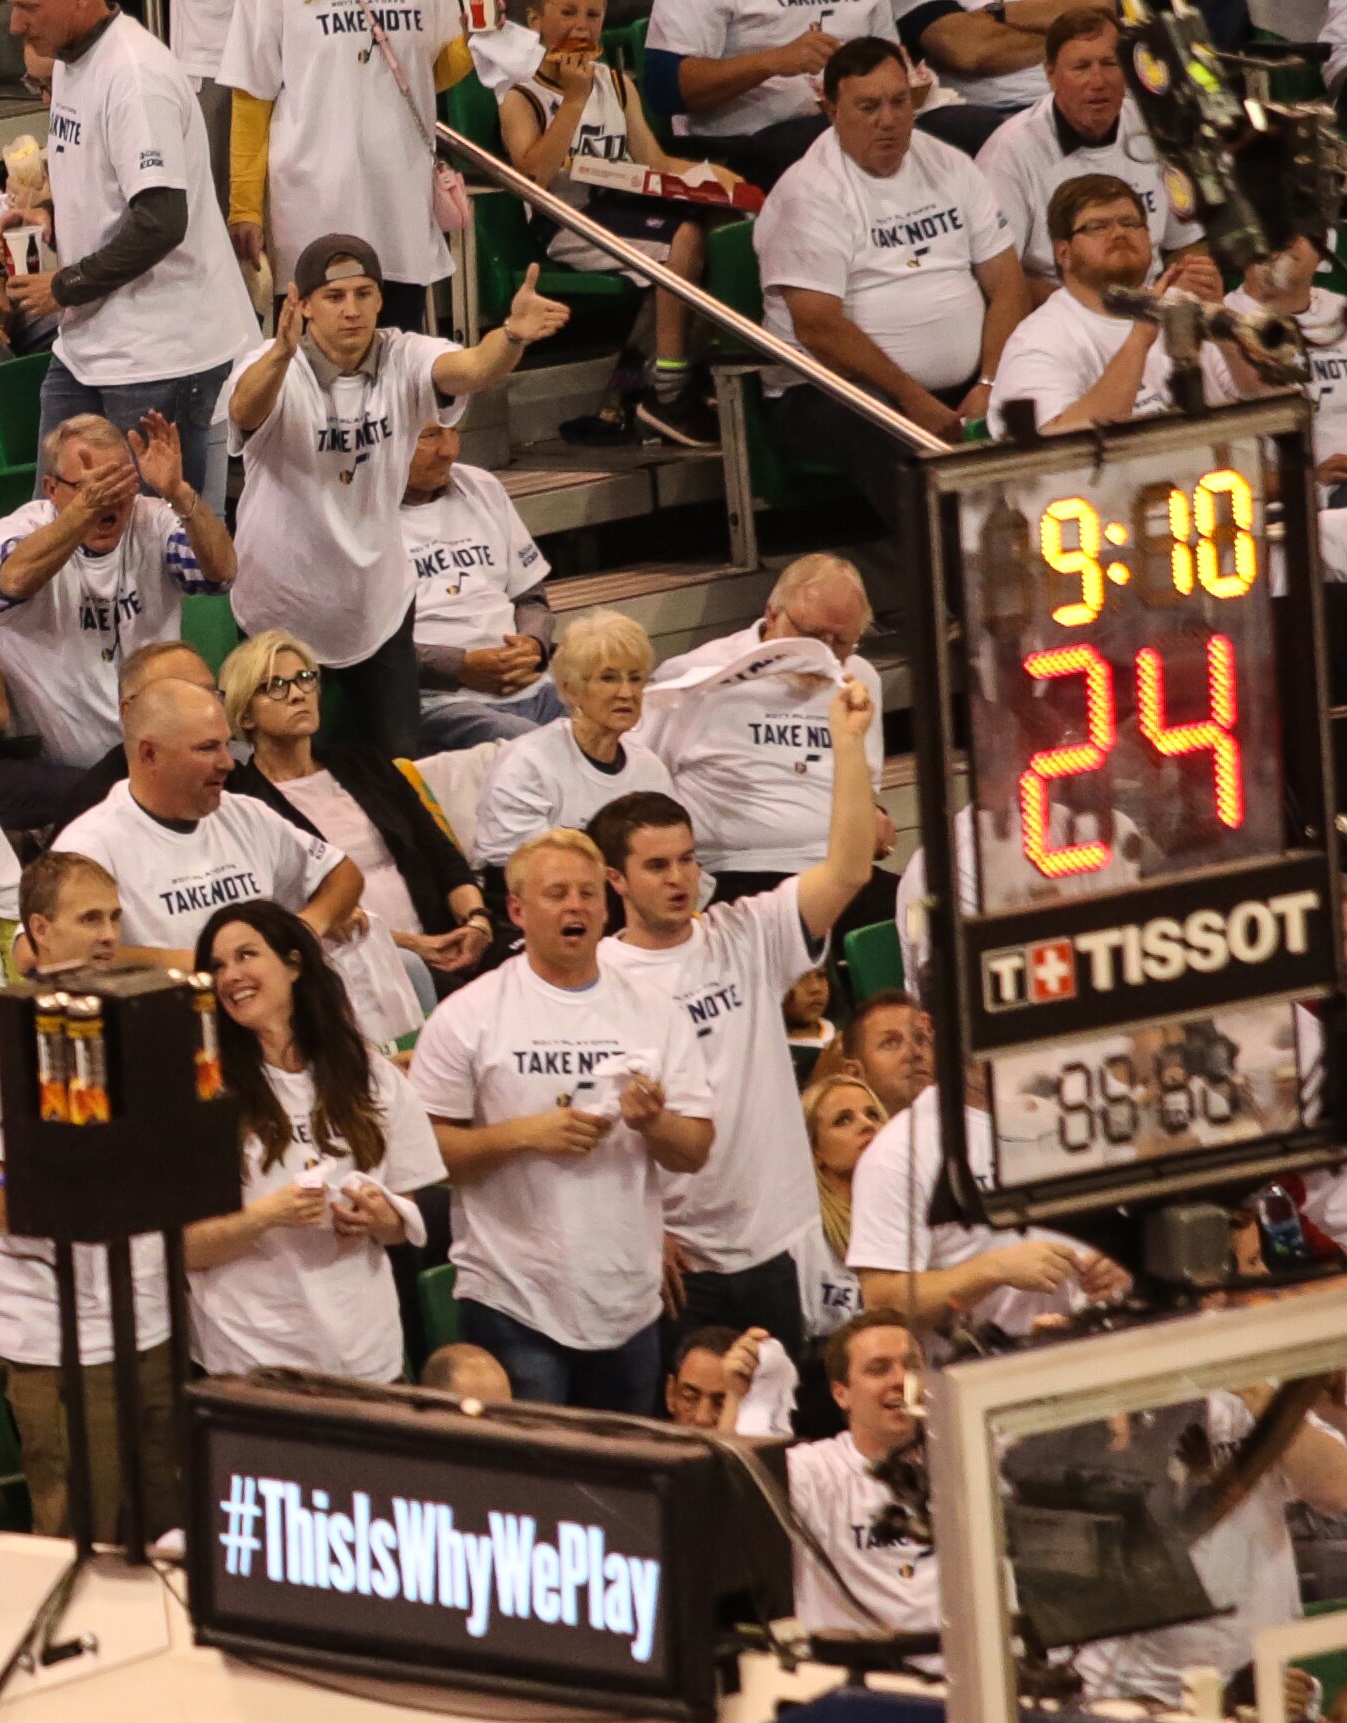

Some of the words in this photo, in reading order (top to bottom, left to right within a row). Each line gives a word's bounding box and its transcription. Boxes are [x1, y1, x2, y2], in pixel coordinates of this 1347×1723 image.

[1041, 469, 1257, 627] 9:10
[1017, 633, 1246, 879] 24
[1074, 890, 1320, 992] TISSOT
[218, 1473, 661, 1663] #ThisIsWhyWePlay
